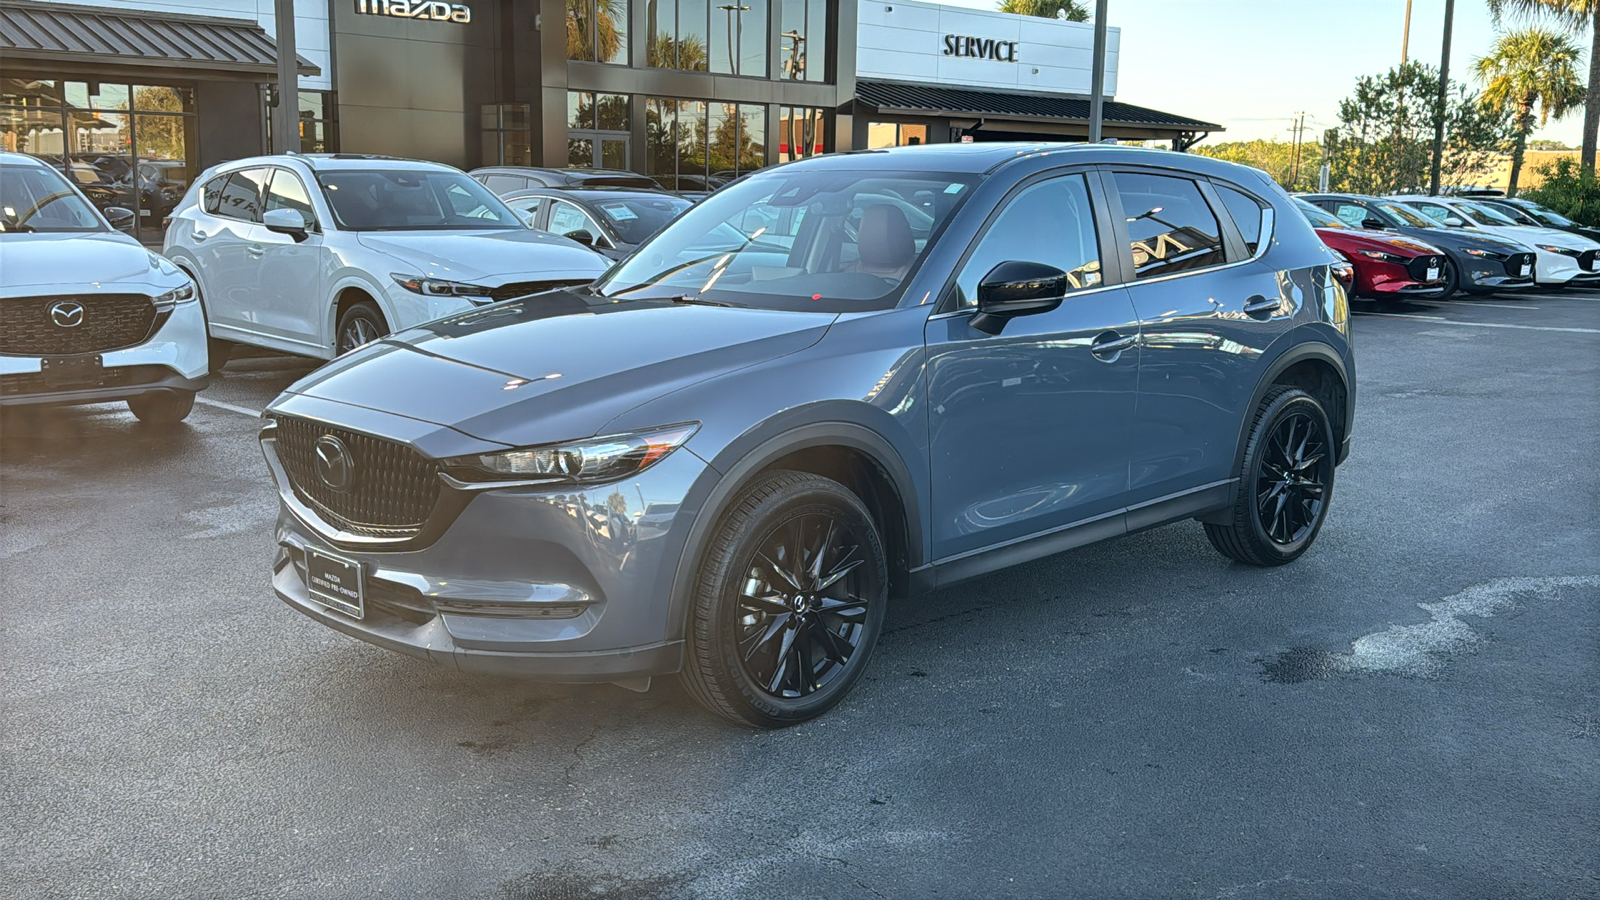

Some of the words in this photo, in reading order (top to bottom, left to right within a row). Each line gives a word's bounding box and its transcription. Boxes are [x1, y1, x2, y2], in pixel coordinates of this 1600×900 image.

[943, 34, 1019, 63] SERVICE
[311, 576, 330, 588] CERTIFIED
[331, 584, 357, 598] PRE-OWNED
[324, 572, 341, 584] MAZDA
